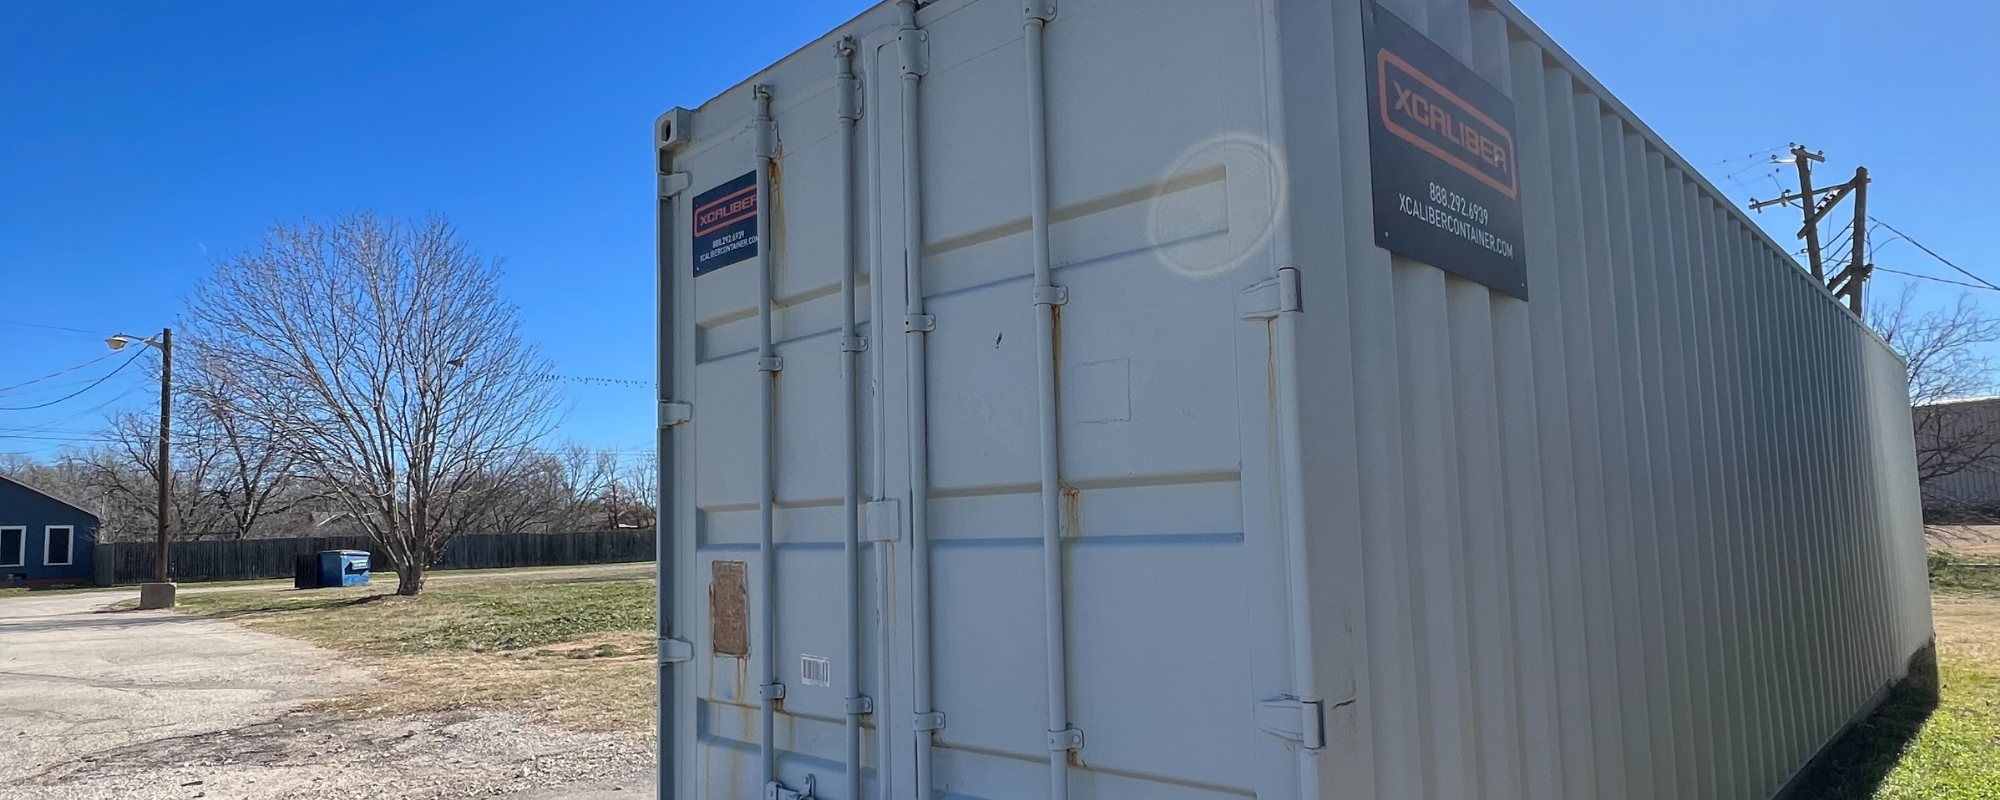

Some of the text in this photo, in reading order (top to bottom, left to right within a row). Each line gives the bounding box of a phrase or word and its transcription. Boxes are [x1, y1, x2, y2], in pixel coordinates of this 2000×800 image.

[1393, 80, 1508, 173] XCALIBER
[1399, 193, 1514, 260] XCALIBERCONTAINER.COM
[1429, 182, 1489, 226] 888.292.6939
[713, 230, 745, 249] 888.292.6939
